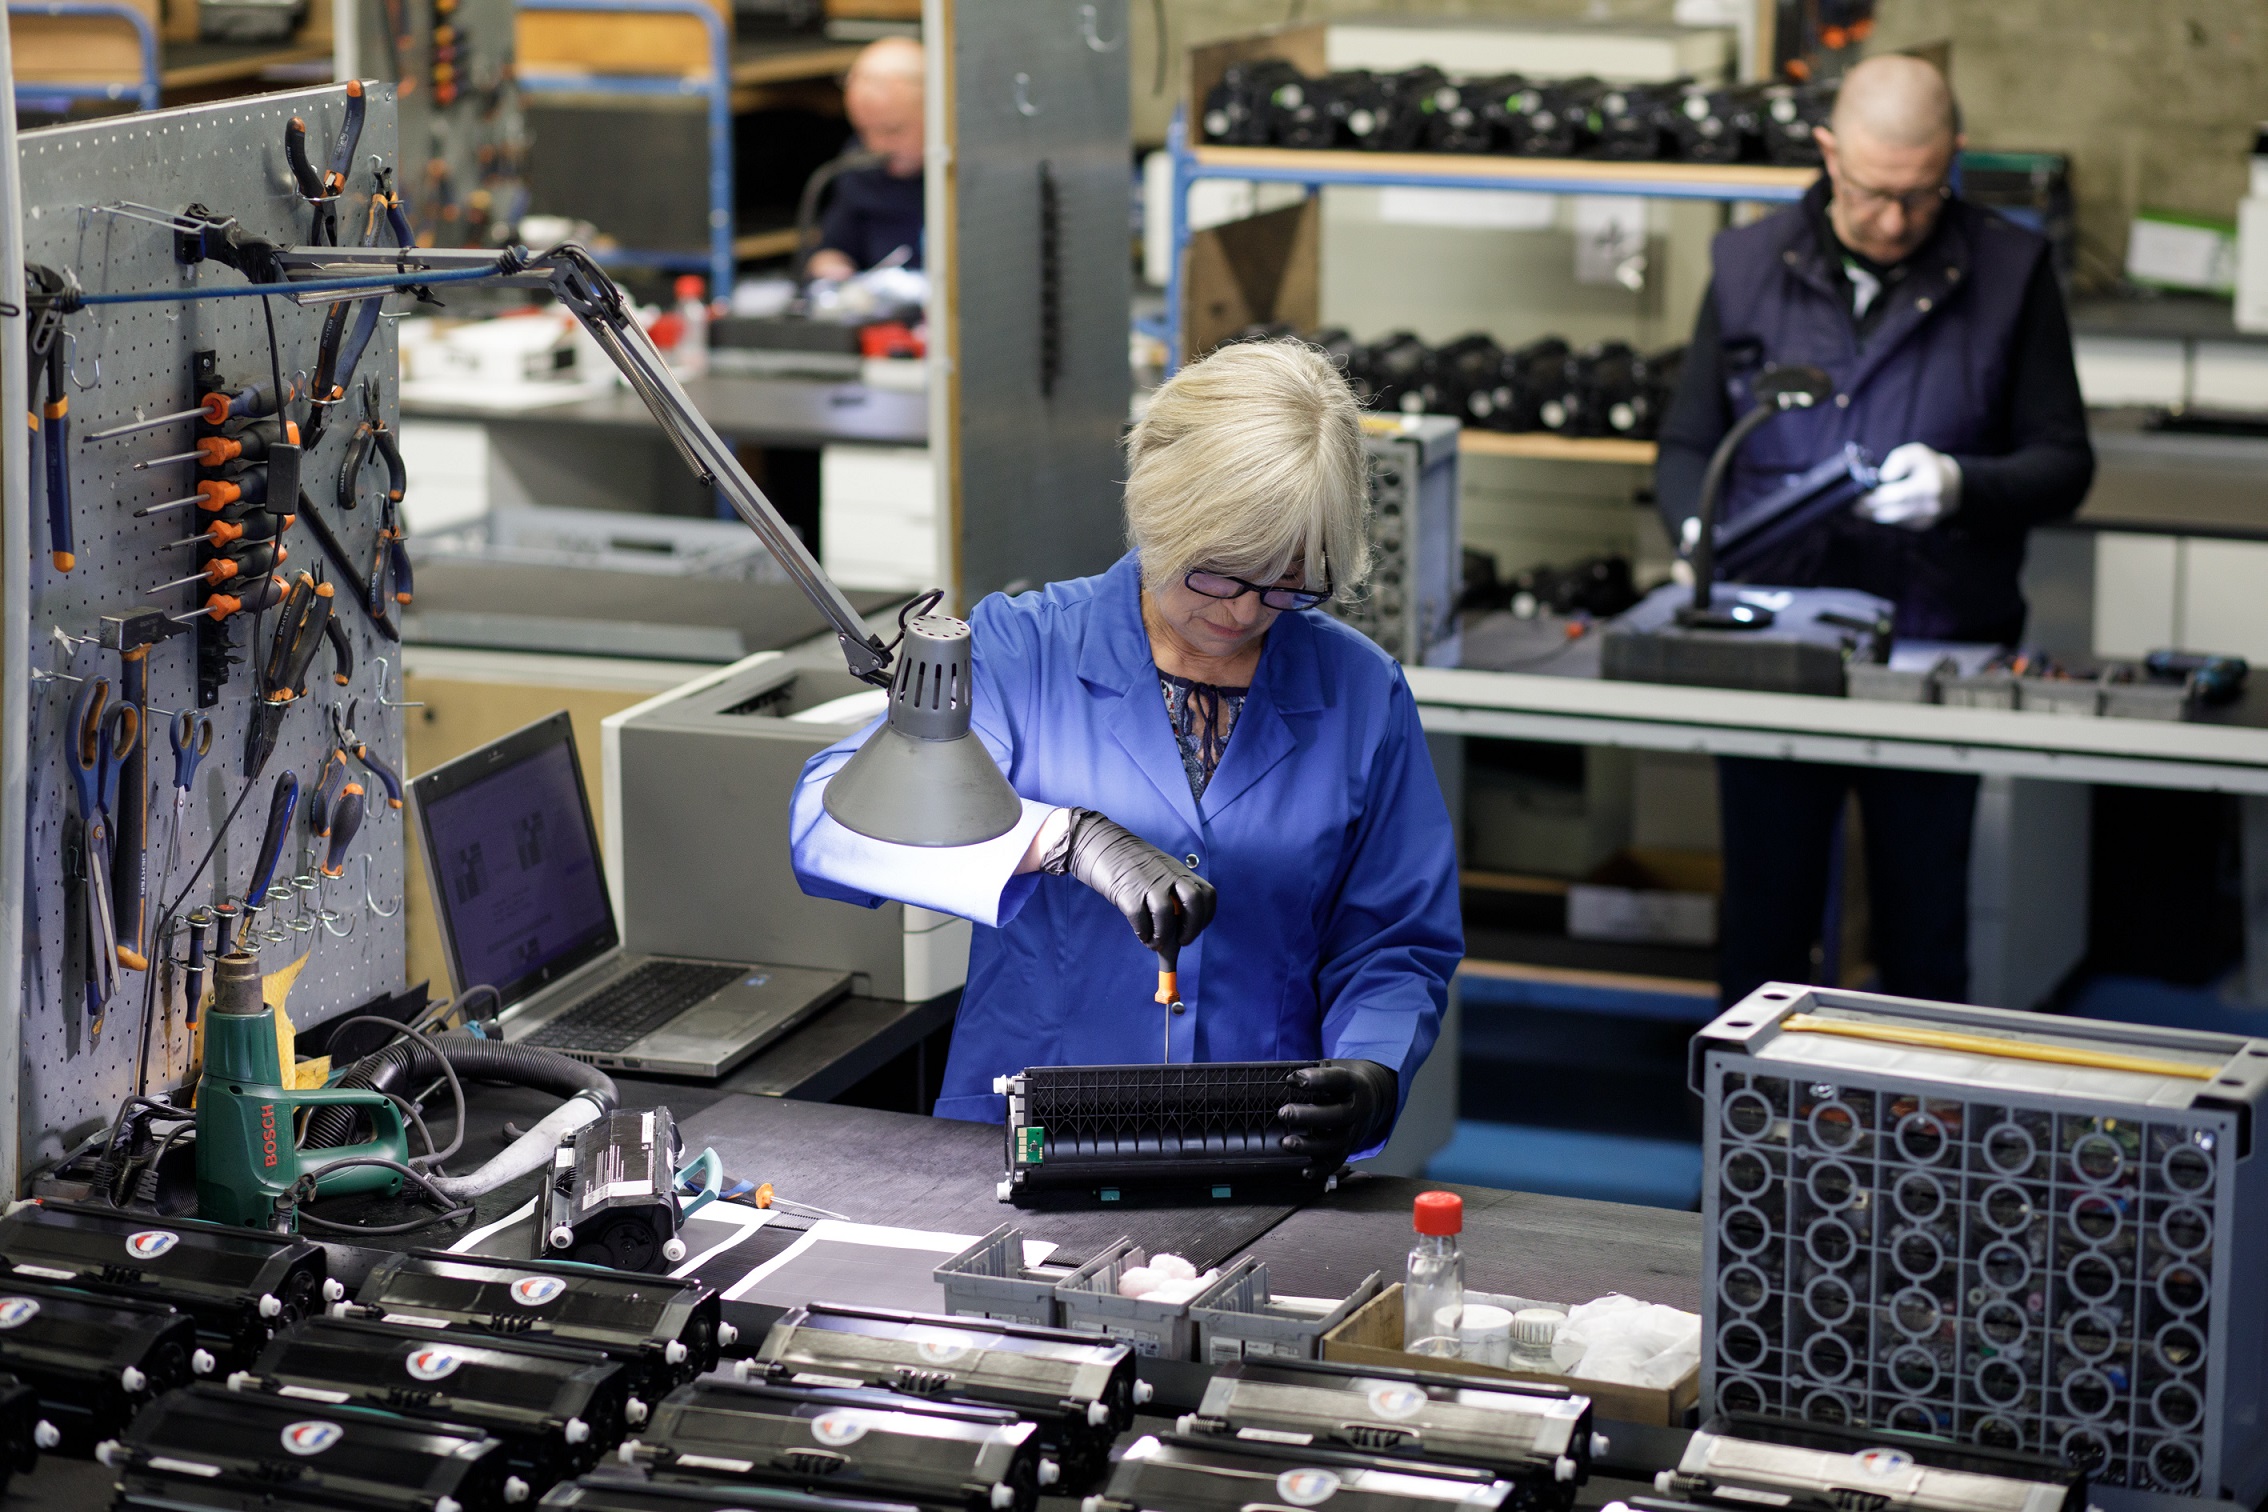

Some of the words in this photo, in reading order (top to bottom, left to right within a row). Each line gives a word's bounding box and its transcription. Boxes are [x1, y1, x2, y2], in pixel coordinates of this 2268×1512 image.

[322, 318, 334, 348] DEXTER
[339, 462, 349, 493] DEXTER
[278, 605, 292, 636] DEXTER
[260, 1104, 278, 1168] BOSCH
